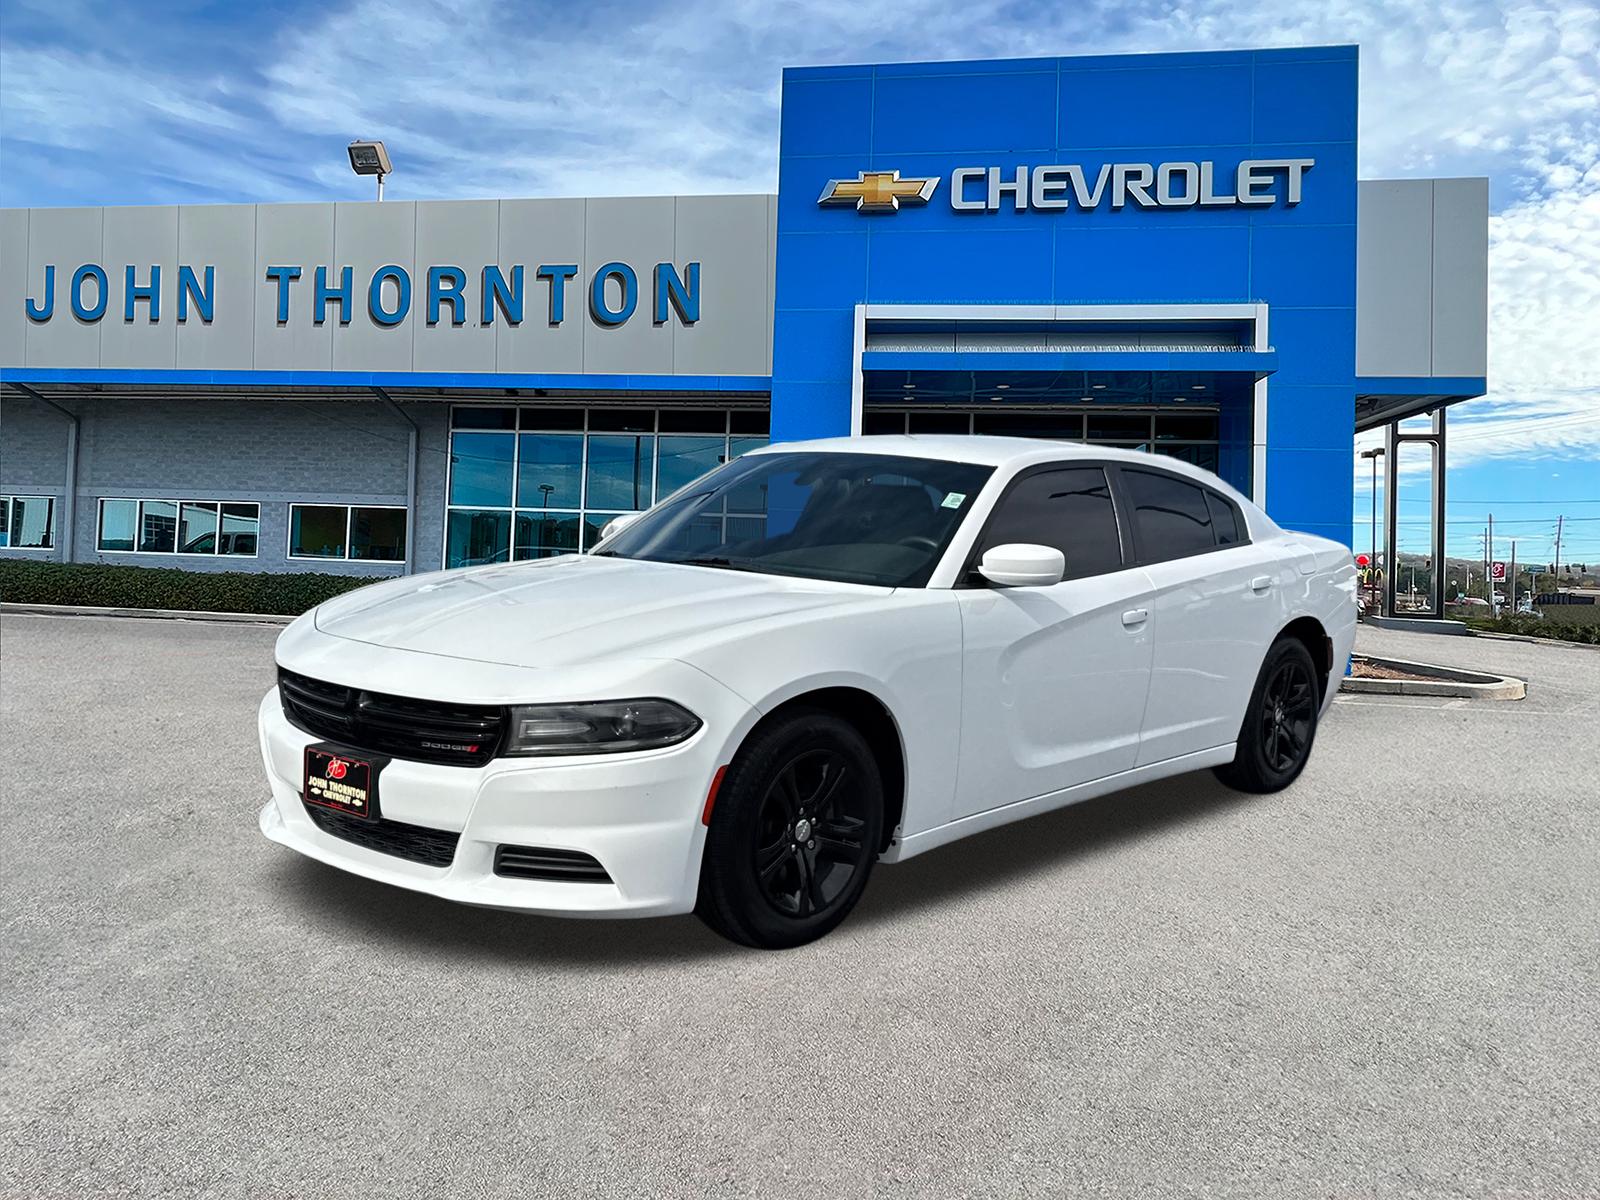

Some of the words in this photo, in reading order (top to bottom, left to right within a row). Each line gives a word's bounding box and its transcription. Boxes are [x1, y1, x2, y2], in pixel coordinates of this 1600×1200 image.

[950, 158, 1315, 211] CHEVROLET
[25, 263, 215, 323] JOHN
[265, 261, 701, 327] THORNTON
[421, 741, 471, 752] DODGE
[308, 775, 328, 789] JOHN
[329, 780, 366, 800] THORNTON
[322, 789, 351, 804] CHEVROLET
